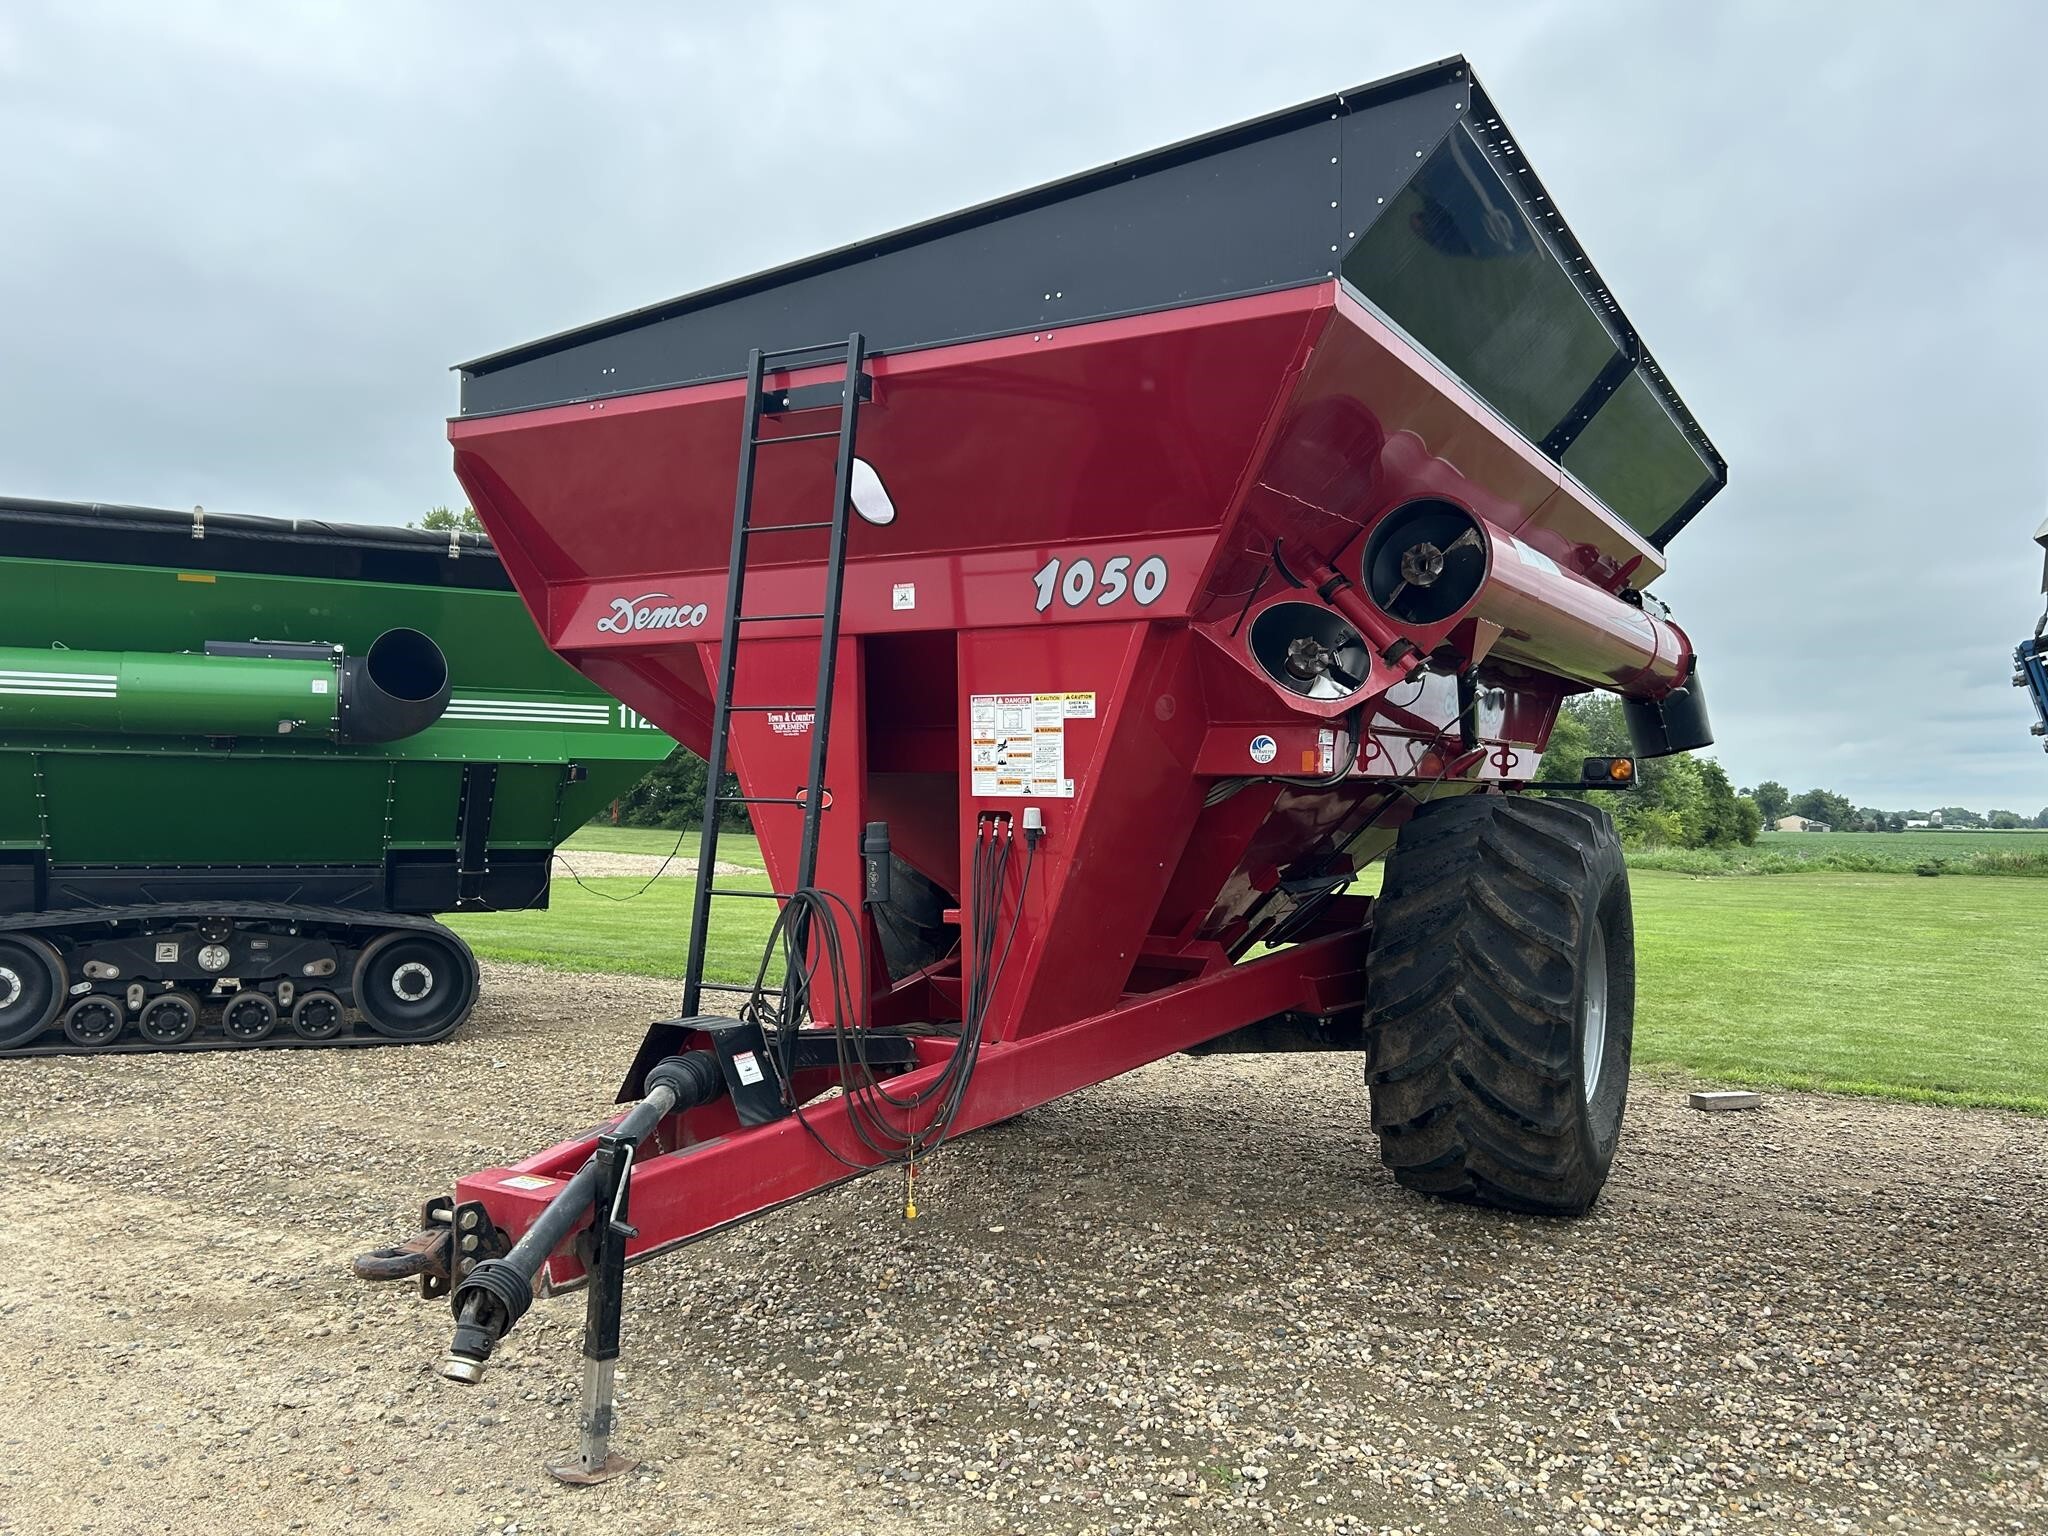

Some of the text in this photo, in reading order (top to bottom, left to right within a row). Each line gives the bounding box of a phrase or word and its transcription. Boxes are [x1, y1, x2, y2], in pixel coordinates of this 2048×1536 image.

[1033, 554, 1168, 614] 1050
[596, 592, 708, 634] Demco
[767, 711, 816, 723] Town & Country
